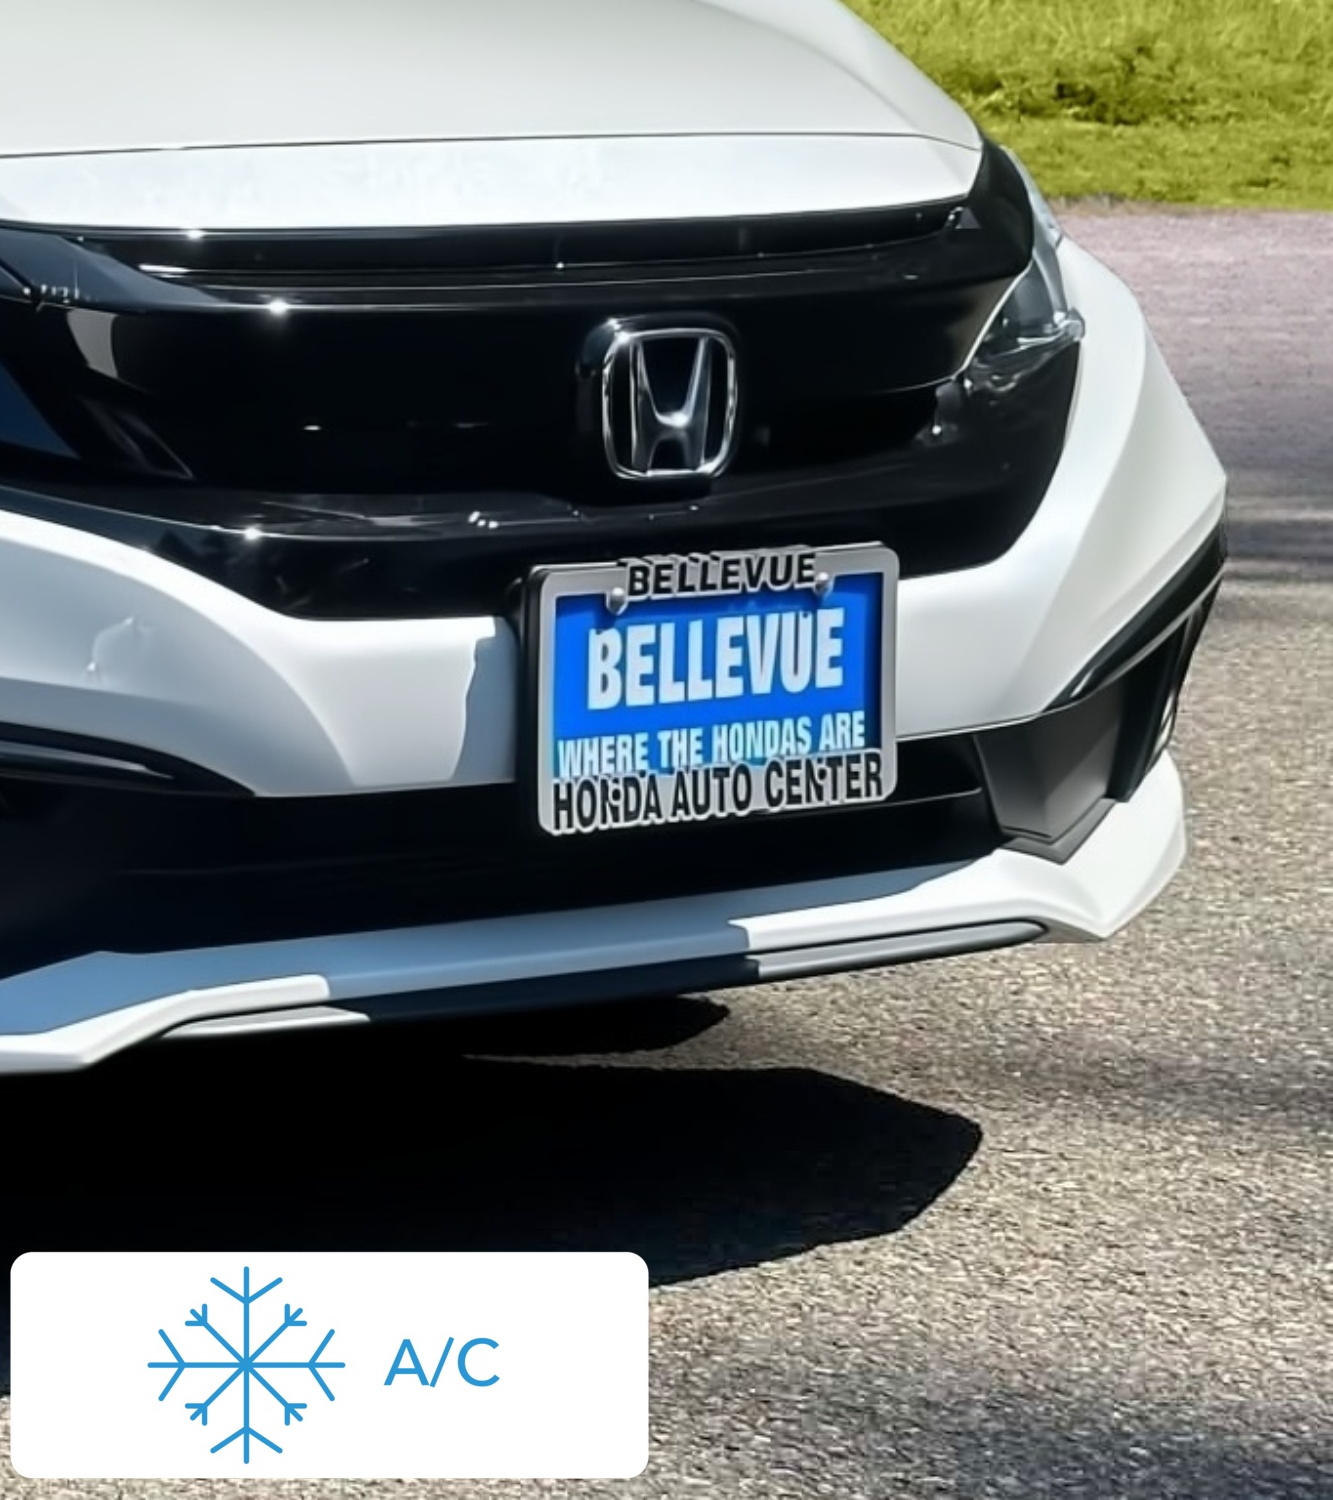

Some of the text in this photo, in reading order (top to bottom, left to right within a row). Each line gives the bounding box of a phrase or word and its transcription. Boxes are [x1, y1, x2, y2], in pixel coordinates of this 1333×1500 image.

[627, 552, 818, 597] BELLEVUE
[587, 607, 846, 711] BELLEVUE
[557, 710, 866, 779] WHERE THE HONDAS ARE
[553, 751, 883, 831] HONDA AUTO CENTER
